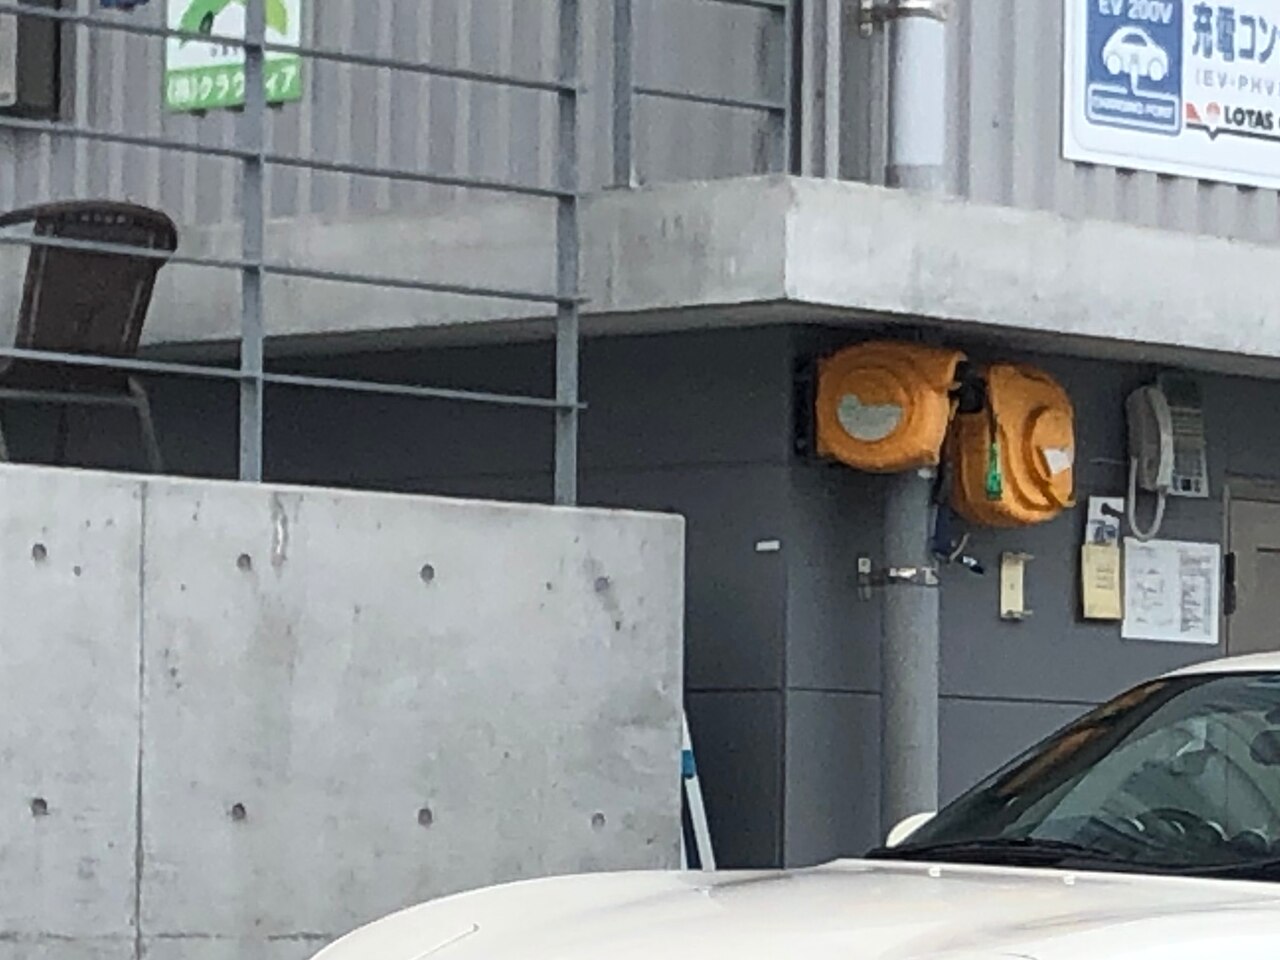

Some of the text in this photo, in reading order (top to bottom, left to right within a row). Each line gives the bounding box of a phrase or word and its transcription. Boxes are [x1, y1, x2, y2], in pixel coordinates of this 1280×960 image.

[1099, 0, 1174, 24] EV 200V
[1223, 105, 1274, 131] LOTAS
